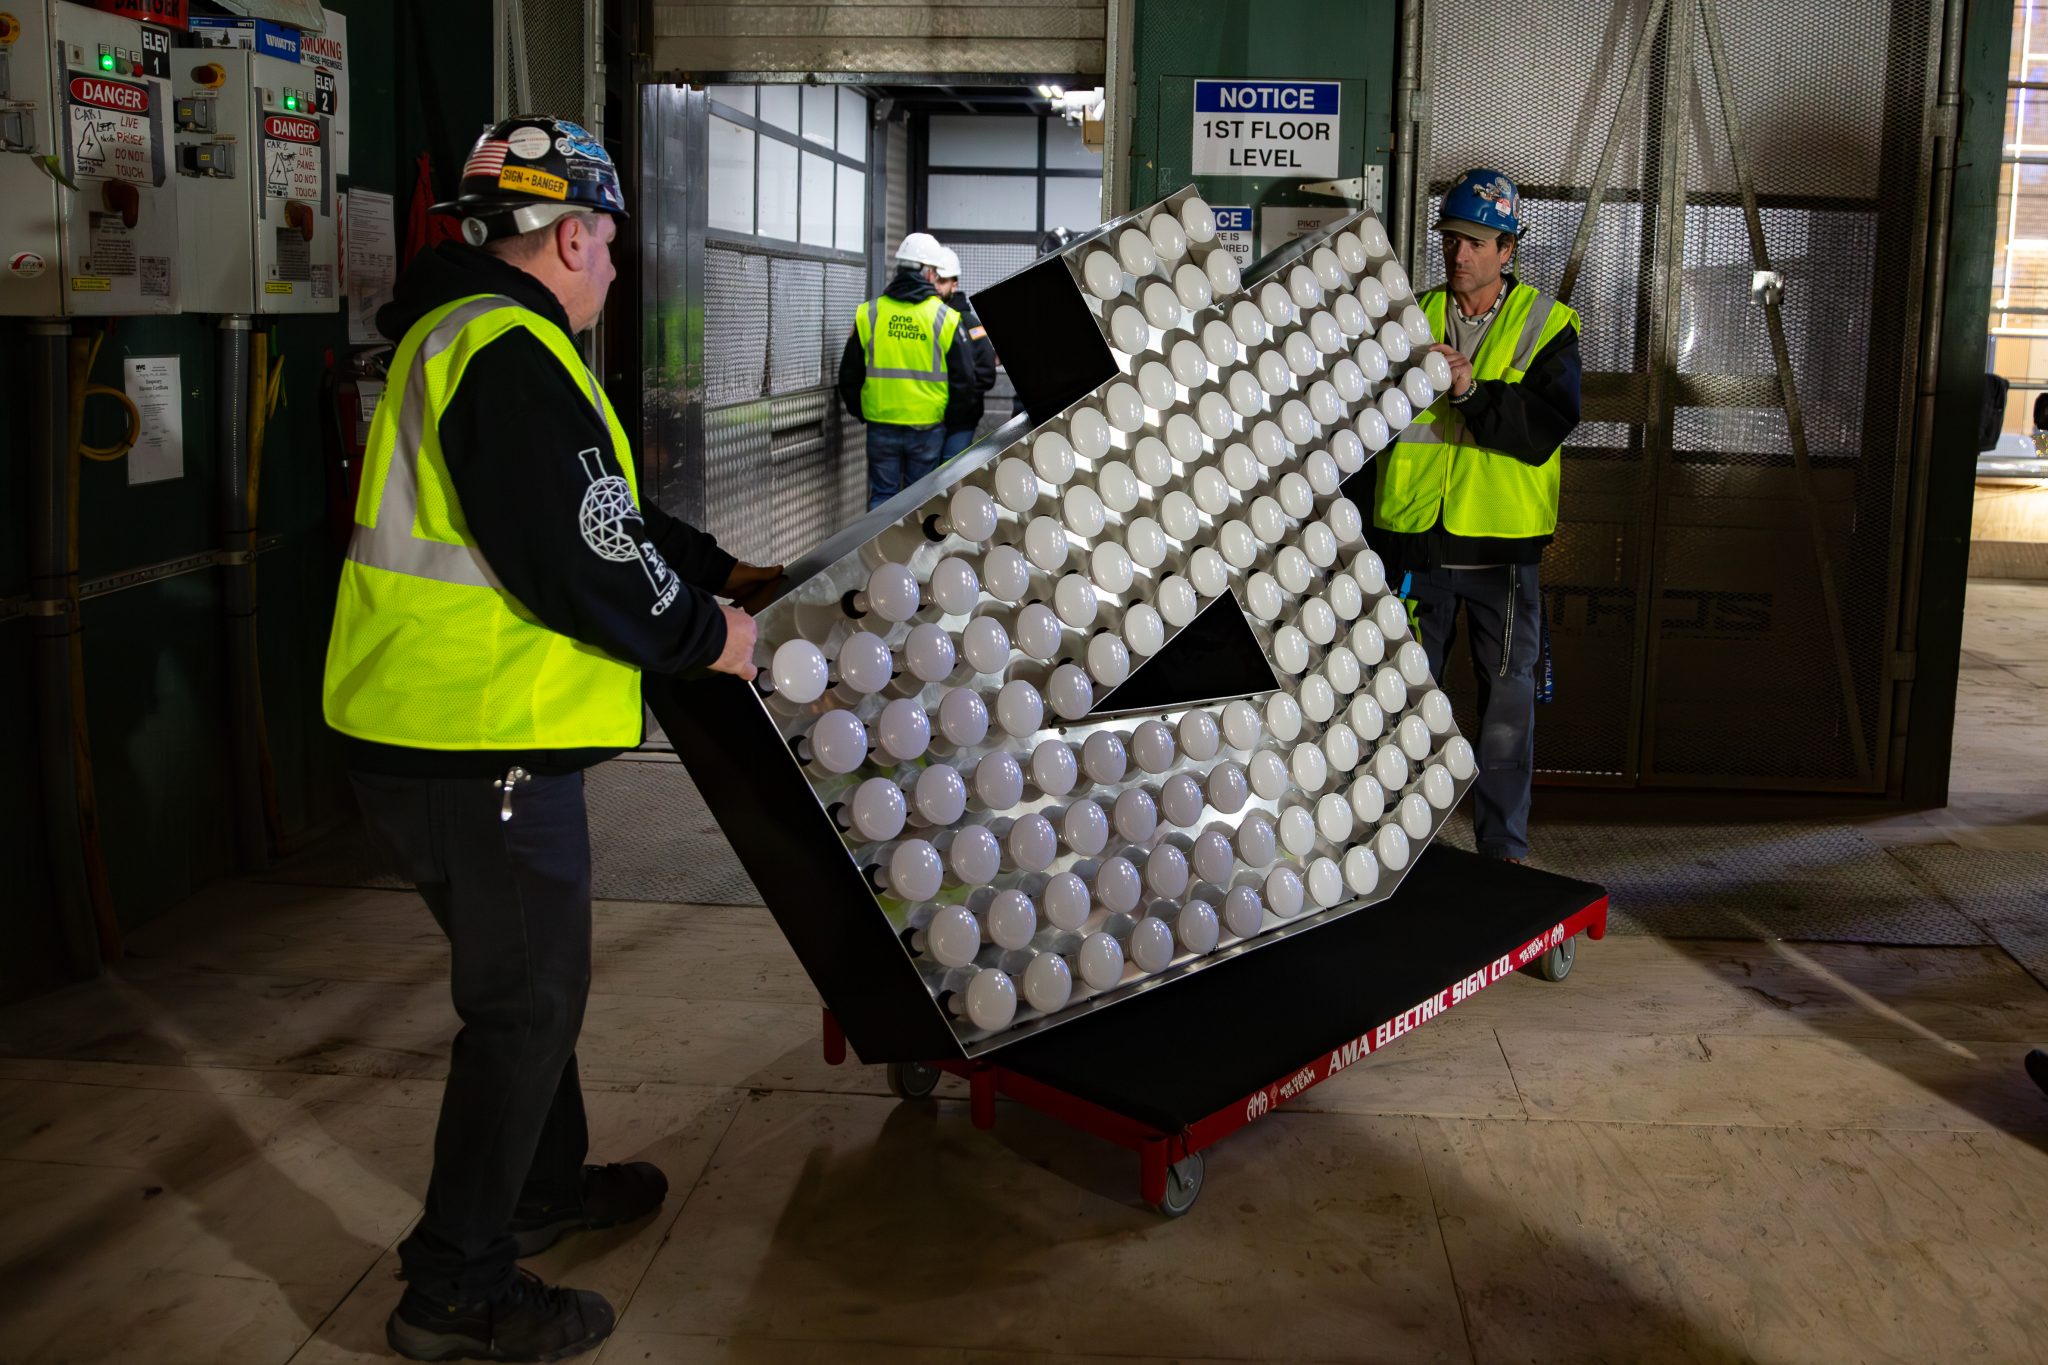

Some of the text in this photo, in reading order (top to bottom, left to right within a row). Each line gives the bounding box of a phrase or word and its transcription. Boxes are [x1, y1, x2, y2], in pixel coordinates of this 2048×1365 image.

[143, 31, 168, 54] ELEV
[265, 33, 297, 53] WATTS
[153, 57, 160, 75] 1
[315, 75, 334, 92] ELEV
[82, 81, 142, 109] DANGER
[322, 95, 329, 112] 2
[1219, 87, 1315, 110] NOTICE
[74, 107, 96, 122] CAR
[120, 117, 139, 129] LIVE
[273, 119, 315, 140] DANGER
[1203, 120, 1331, 141] 1ST FLOOR
[266, 141, 282, 150] CAR
[299, 147, 313, 157] LIVE
[115, 148, 144, 162] DO NOT
[1229, 148, 1302, 168] LEVEL
[115, 164, 144, 178] TOUCH
[297, 159, 315, 171] PANEL
[294, 173, 317, 185] DO NOT
[502, 169, 565, 193] SIGN BANGER
[295, 187, 317, 198] TOUCH
[1230, 233, 1240, 241] IS
[888, 321, 919, 332] times
[891, 314, 913, 323] one
[888, 329, 927, 341] square
[1327, 954, 1514, 1076] AMA ELECTRIC SIGN CO.
[1294, 1069, 1316, 1093] TEAM
[1246, 1090, 1268, 1122] AMA
